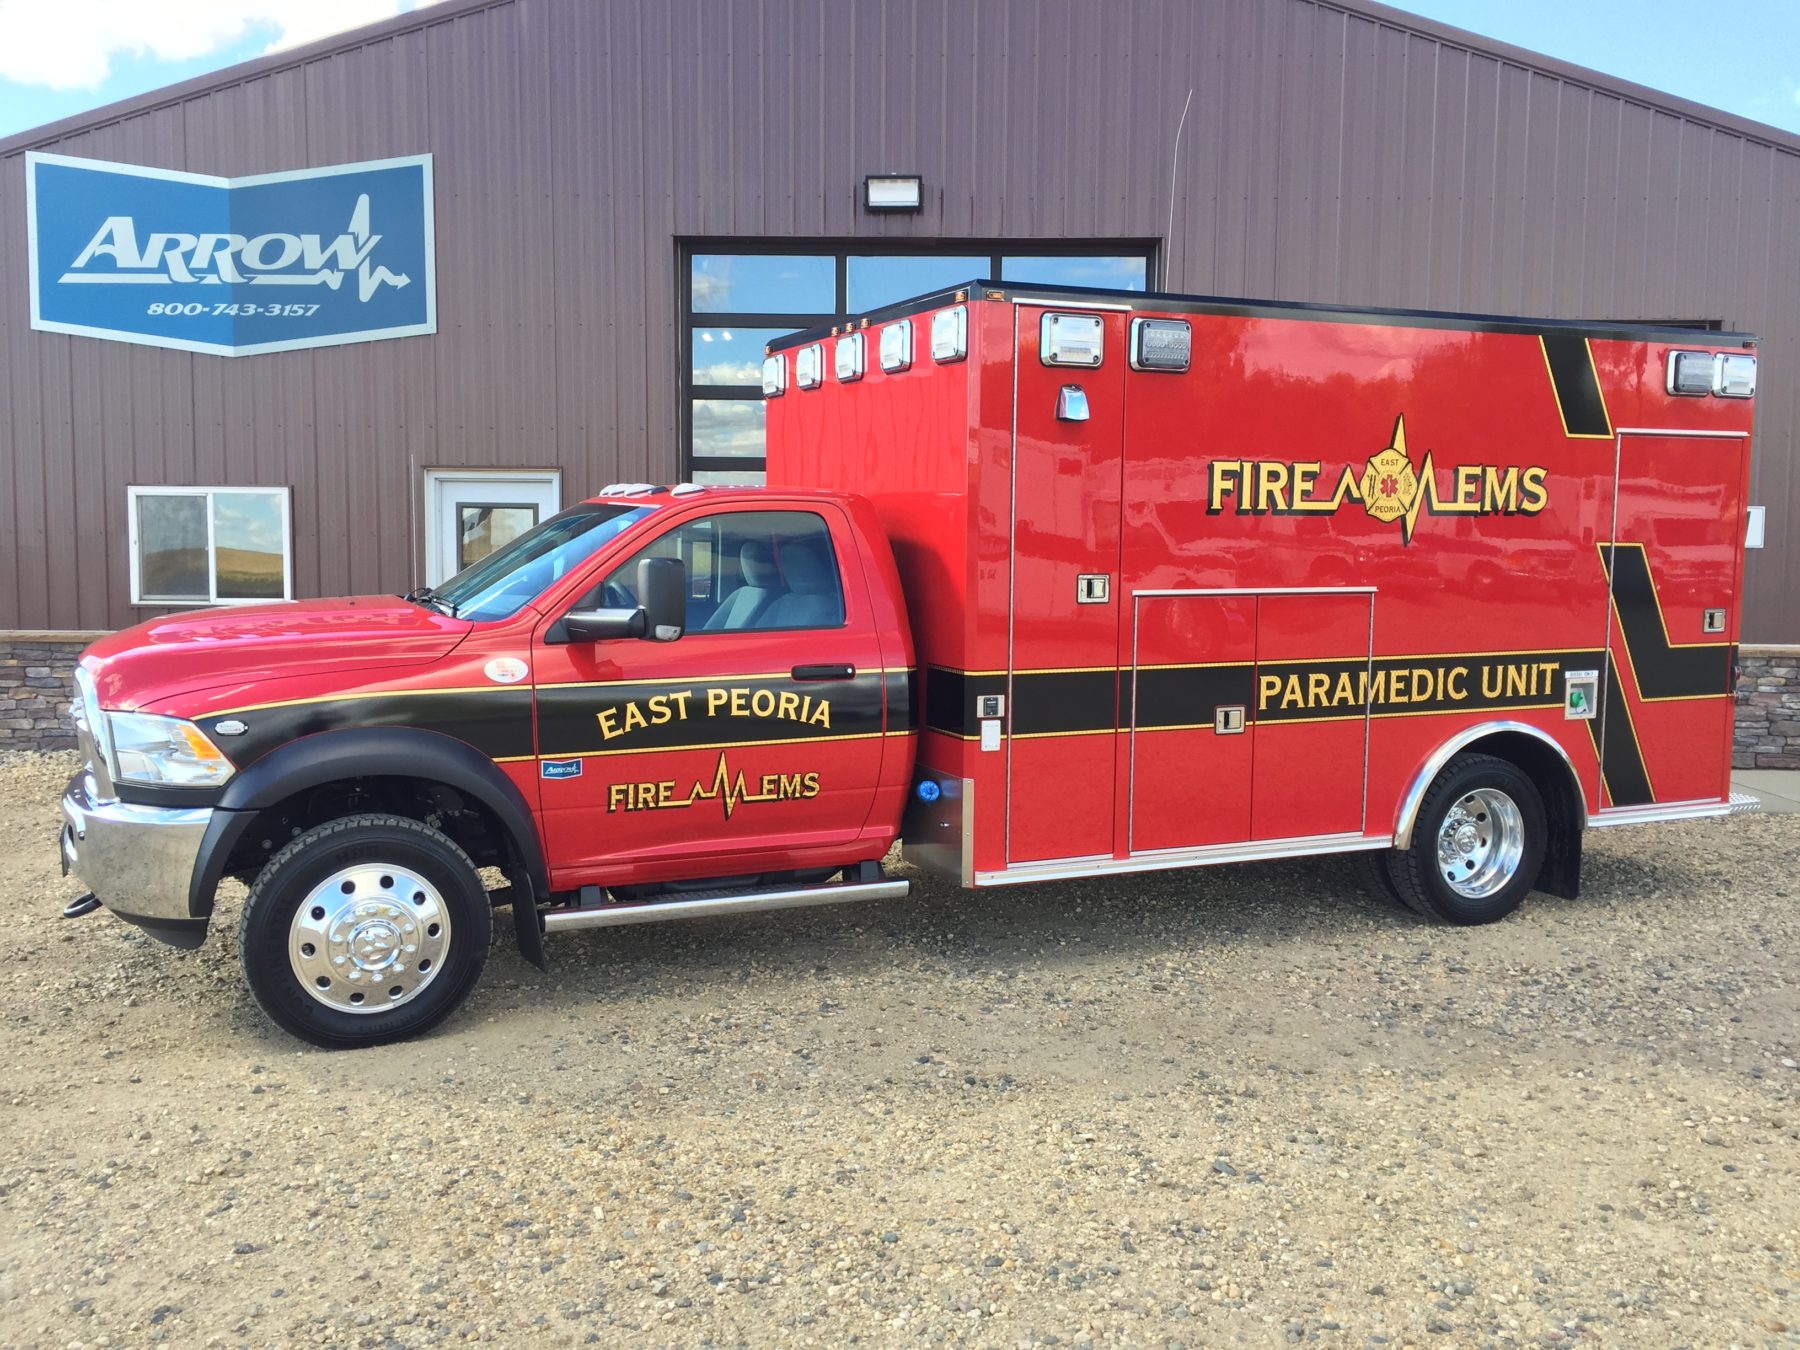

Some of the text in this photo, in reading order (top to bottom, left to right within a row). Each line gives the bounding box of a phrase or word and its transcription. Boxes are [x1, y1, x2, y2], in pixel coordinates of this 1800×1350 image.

[70, 216, 383, 285] ARROW
[147, 302, 320, 317] 800-743-3157
[1380, 458, 1399, 466] EAST
[1206, 459, 1549, 517] FIRE EMS
[1374, 505, 1402, 514] PEORIA
[1258, 662, 1560, 711] PARAMEDIC UNIT
[596, 687, 831, 741] EAST PEORIA
[607, 772, 820, 814] FIRE EMS
